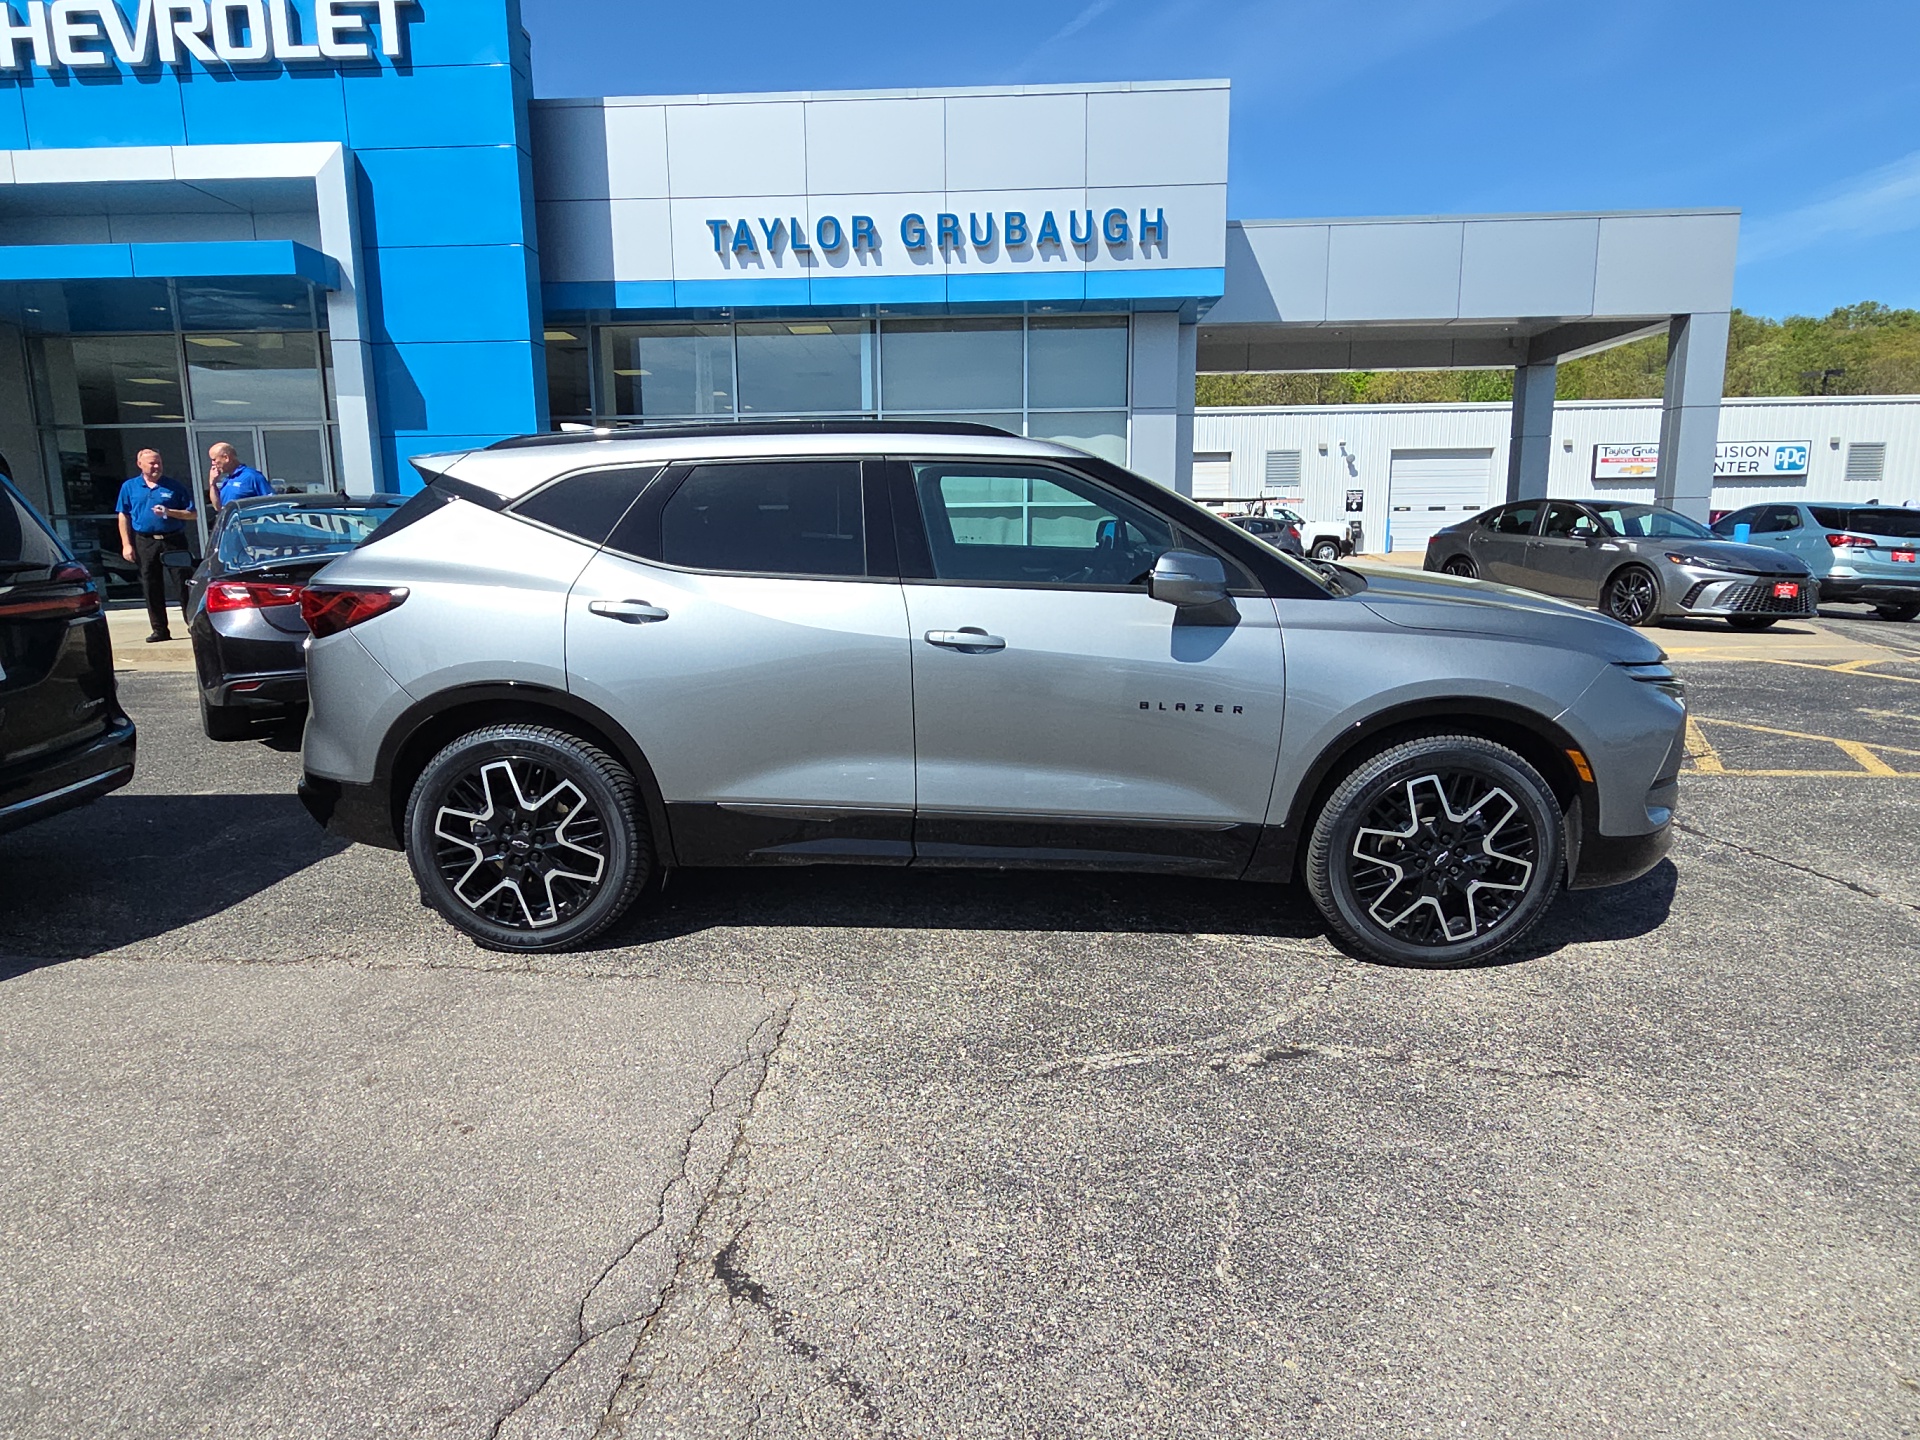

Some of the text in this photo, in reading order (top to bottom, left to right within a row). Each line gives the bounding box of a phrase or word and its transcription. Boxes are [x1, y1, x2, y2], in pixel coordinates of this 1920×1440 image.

[705, 207, 1164, 252] TAYLOR GRUBAUGH
[1601, 446, 1630, 457] Taylor
[1775, 448, 1805, 469] PPG
[1713, 461, 1759, 473] NTER
[1139, 701, 1243, 715] BLAZER
